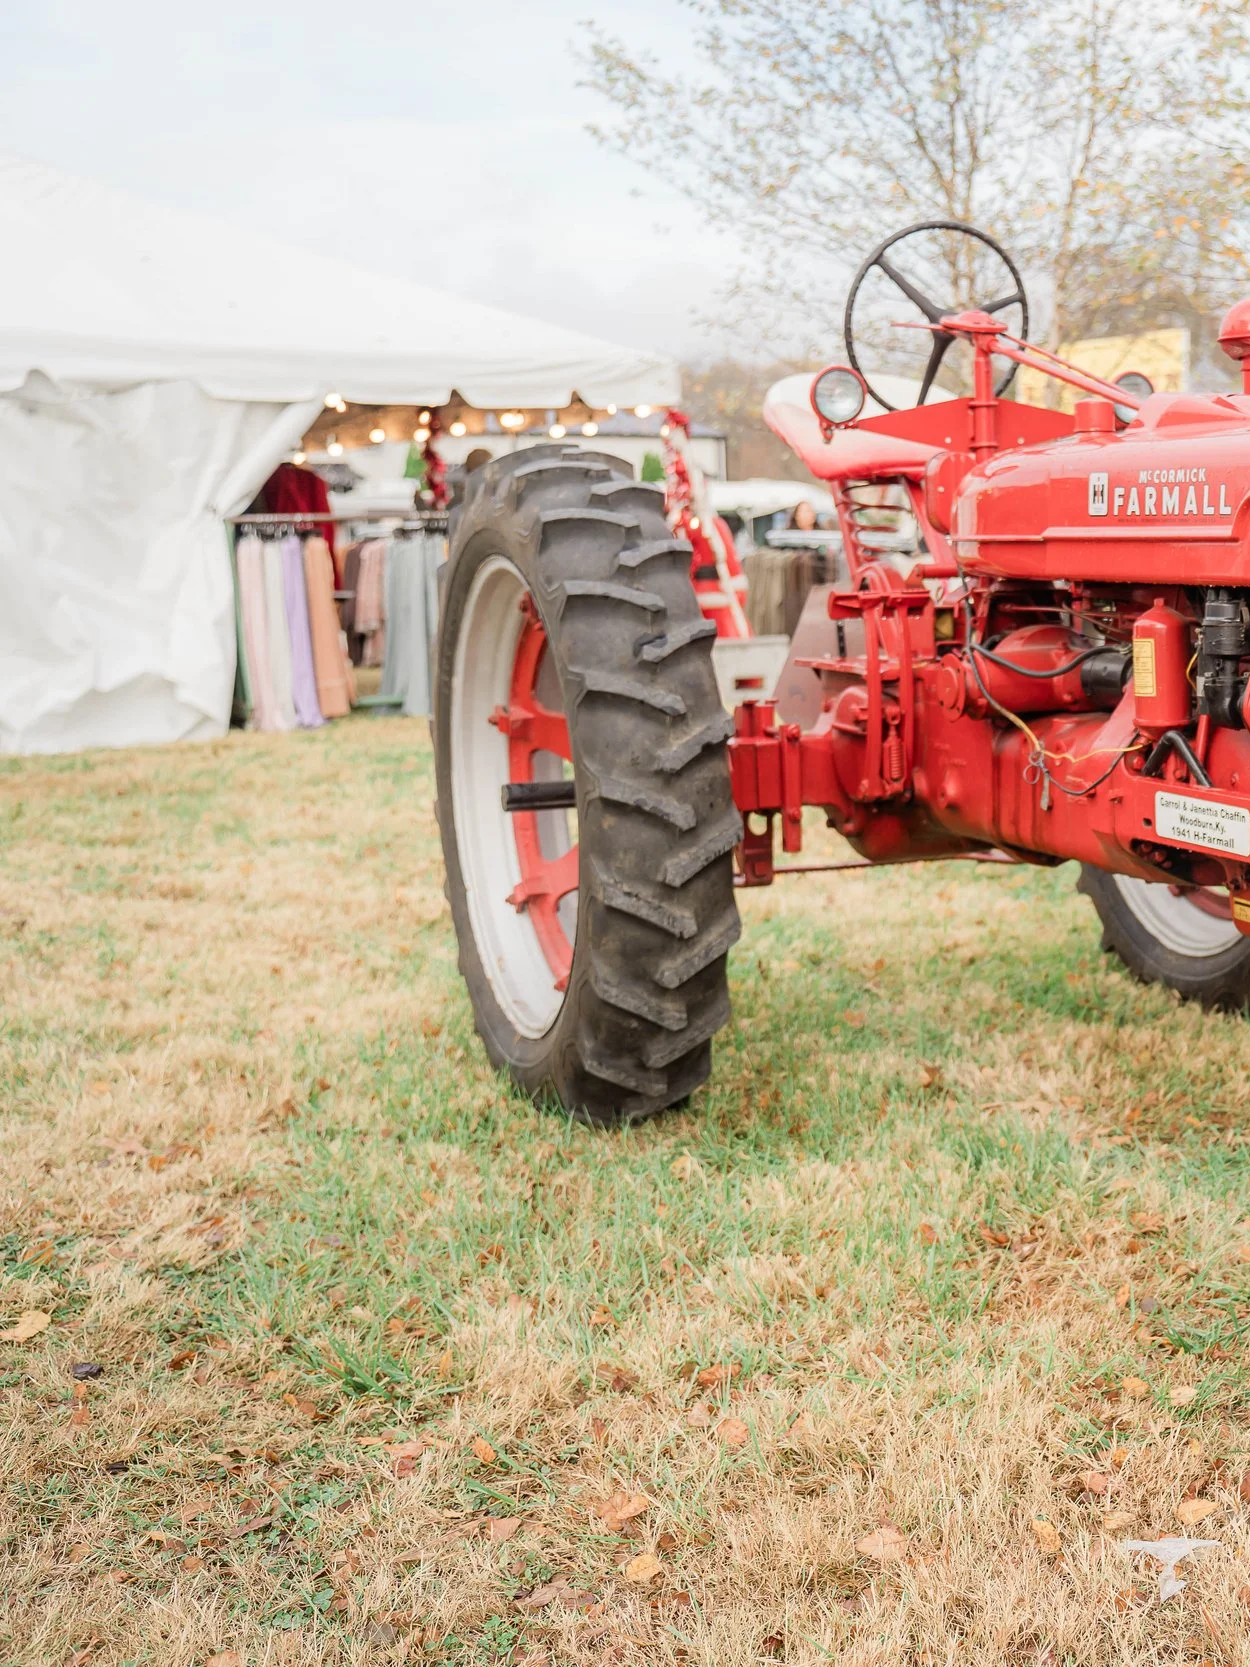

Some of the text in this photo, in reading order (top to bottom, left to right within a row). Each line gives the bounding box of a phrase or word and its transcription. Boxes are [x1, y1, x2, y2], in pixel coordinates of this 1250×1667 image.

[1113, 484, 1232, 516] FARMALL
[1160, 797, 1180, 809] Carrol
[1183, 801, 1188, 811] &
[1220, 808, 1246, 824] Chaffin
[1171, 826, 1235, 849] 1941 H-Farmall
